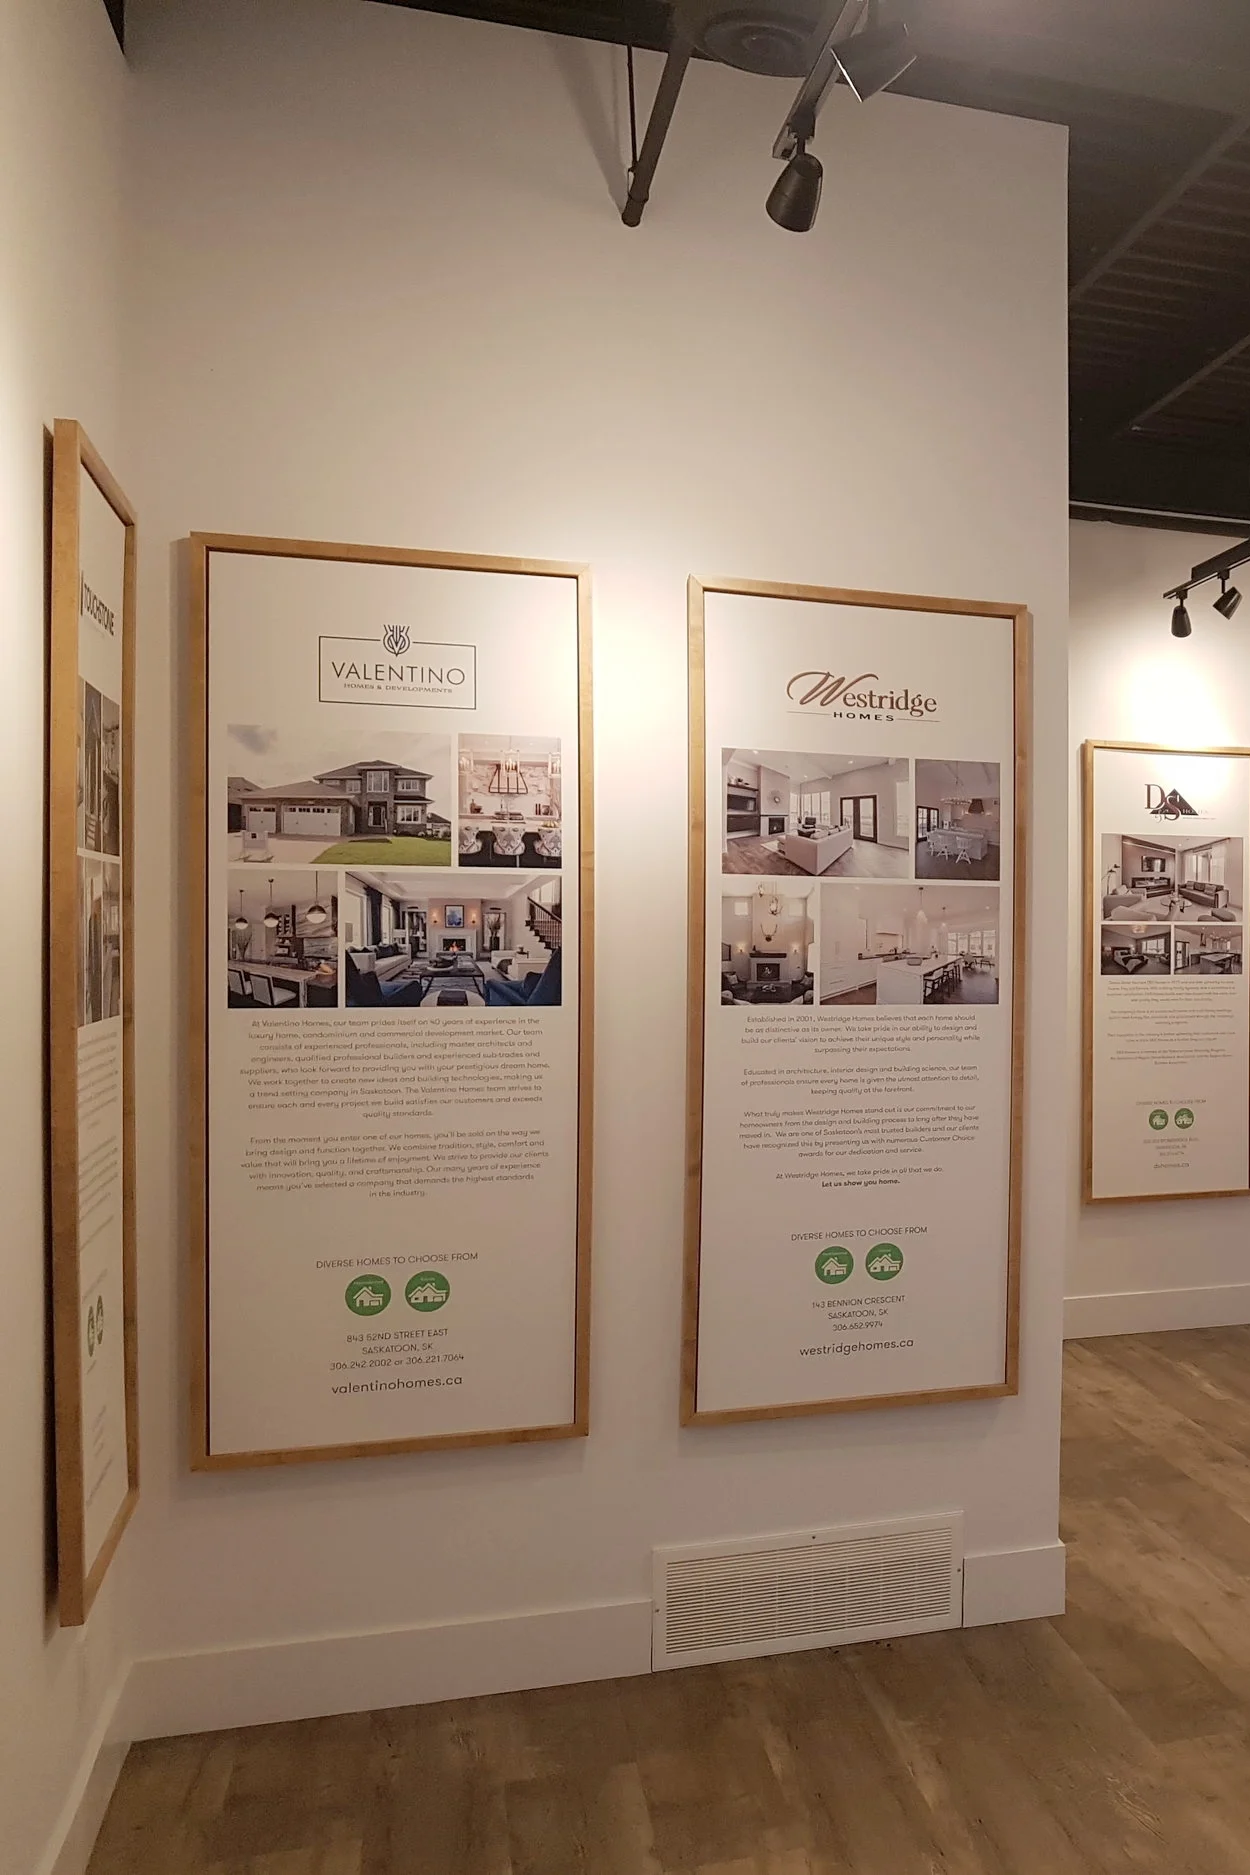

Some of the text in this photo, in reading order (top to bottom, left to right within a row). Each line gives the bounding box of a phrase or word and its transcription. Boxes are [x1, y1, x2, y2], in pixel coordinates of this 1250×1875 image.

[84, 583, 115, 636] TOUCHSTONE
[332, 661, 465, 686] VALENTINO
[344, 683, 375, 691] HOMES
[385, 685, 453, 693] DEVELOPMENTS
[786, 671, 937, 718] Westridge
[833, 711, 894, 722] HOMES
[262, 1018, 300, 1028] Valentino
[302, 1018, 332, 1028] Homes,
[349, 1018, 369, 1027] team
[371, 1018, 395, 1028] prides
[397, 1018, 416, 1026] itself
[442, 1019, 463, 1028] years
[465, 1017, 473, 1025] of
[475, 1017, 517, 1028] experience
[518, 1016, 527, 1025] in
[528, 1017, 541, 1025] the
[747, 1015, 786, 1023] Established
[817, 1015, 850, 1024] Westridge
[876, 1014, 903, 1022] believes
[903, 1014, 917, 1022] that
[954, 1013, 976, 1021] should
[249, 1172, 267, 1180] with
[269, 1171, 313, 1180] innovation,
[316, 1169, 347, 1178] quality,
[348, 1168, 364, 1176] and
[426, 1164, 441, 1172] Our
[443, 1165, 466, 1173] many
[467, 1163, 489, 1173] years
[490, 1162, 499, 1170] of
[500, 1162, 541, 1171] experience
[784, 1171, 818, 1180] Westridge
[820, 1170, 845, 1178] Homes,
[872, 1168, 890, 1177] pride
[908, 1166, 922, 1174] that
[821, 1180, 832, 1188] Let
[863, 1180, 878, 1188] you
[878, 1178, 900, 1186] home.
[369, 1190, 377, 1198] in
[379, 1190, 391, 1198] the
[791, 1225, 928, 1241] DIVERSE HOMES TO CHOOSE FROM
[316, 1252, 478, 1269] DIVERSE HOMES TO CHOOSE FROM
[812, 1294, 905, 1309] 143 BENNION CRESCENT
[828, 1308, 889, 1320] SASKATOON, SK
[366, 1332, 391, 1342] 52ND
[393, 1330, 425, 1340] STREET
[427, 1328, 448, 1337] EAST
[362, 1343, 433, 1355] SASKATOON, SK
[799, 1338, 914, 1356] westridgehomes.ca
[329, 1359, 391, 1371] 306.242.2002
[331, 1376, 463, 1394] valentinohomes.ca
